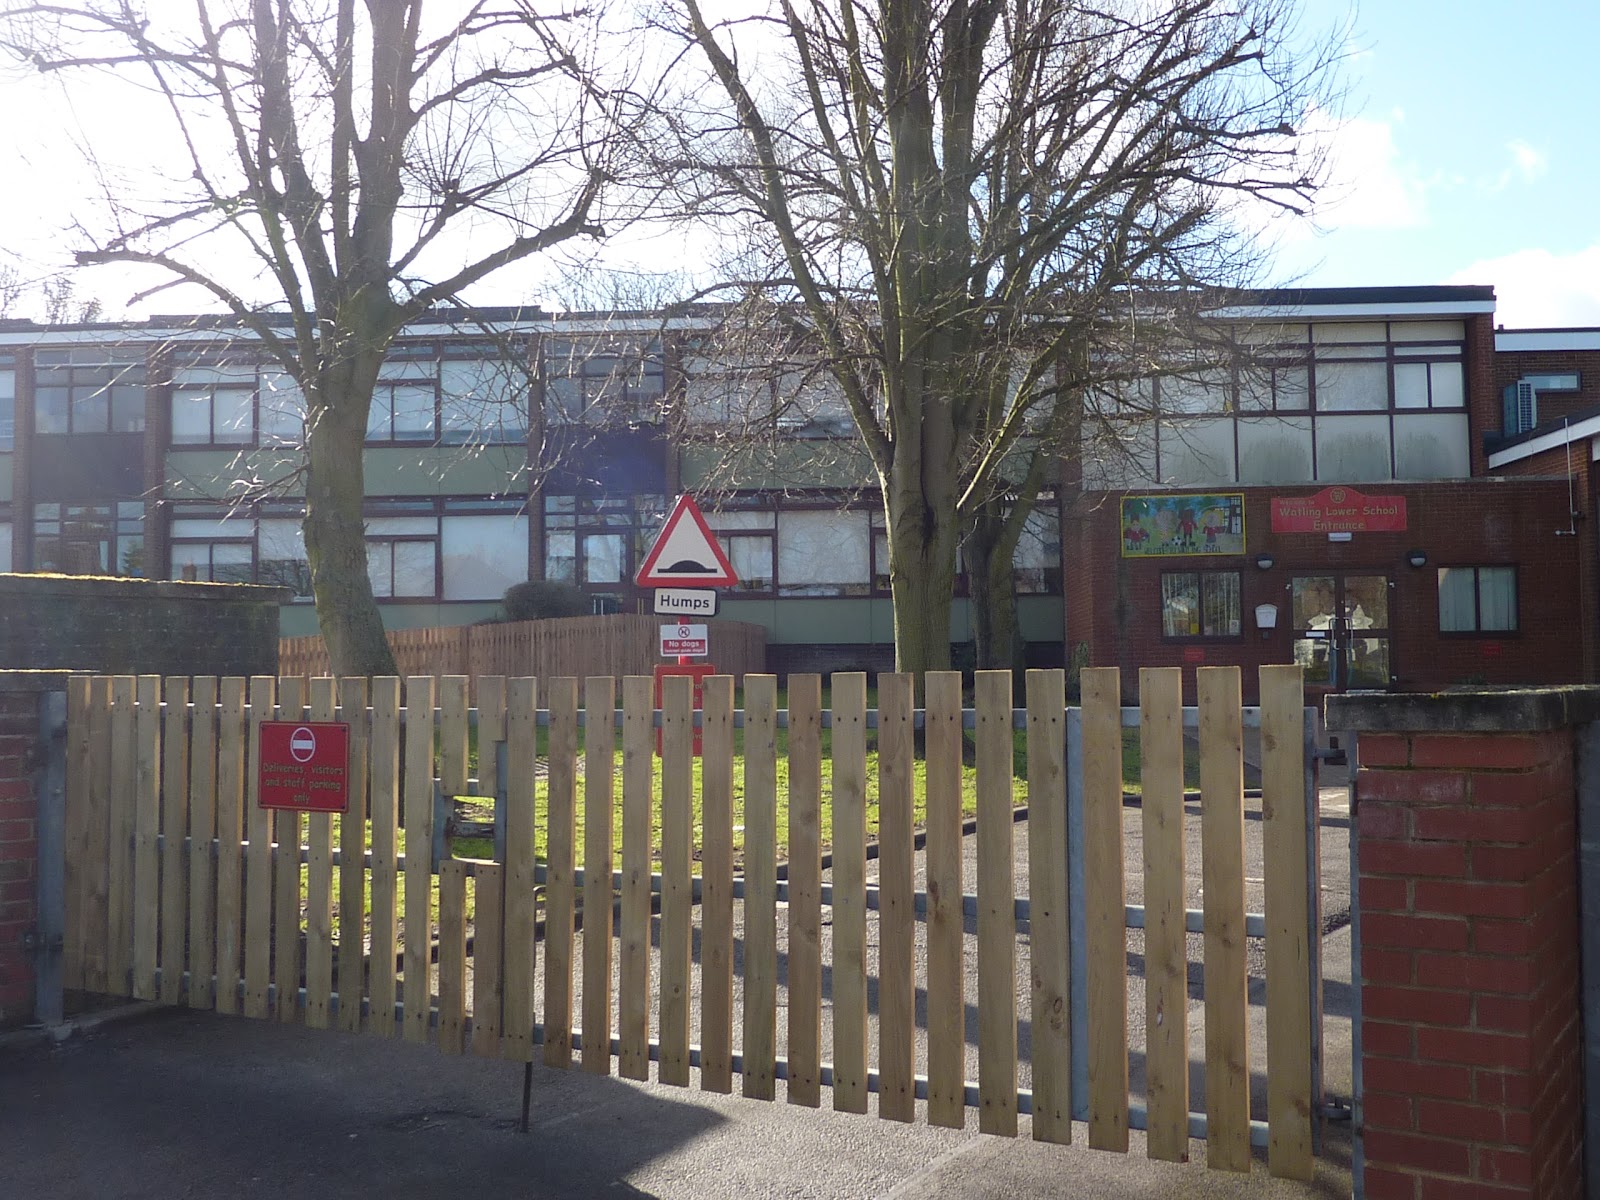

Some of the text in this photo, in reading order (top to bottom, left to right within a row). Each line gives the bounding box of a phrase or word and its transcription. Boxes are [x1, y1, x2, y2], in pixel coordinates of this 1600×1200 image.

[1280, 505, 1398, 518] Watling Lower School
[1313, 520, 1366, 531] Entrance
[660, 594, 710, 610] Humps
[668, 640, 700, 648] No dogs
[263, 762, 344, 775] Deliveries, visitors
[265, 777, 342, 792] and staff parking
[293, 792, 311, 804] only
